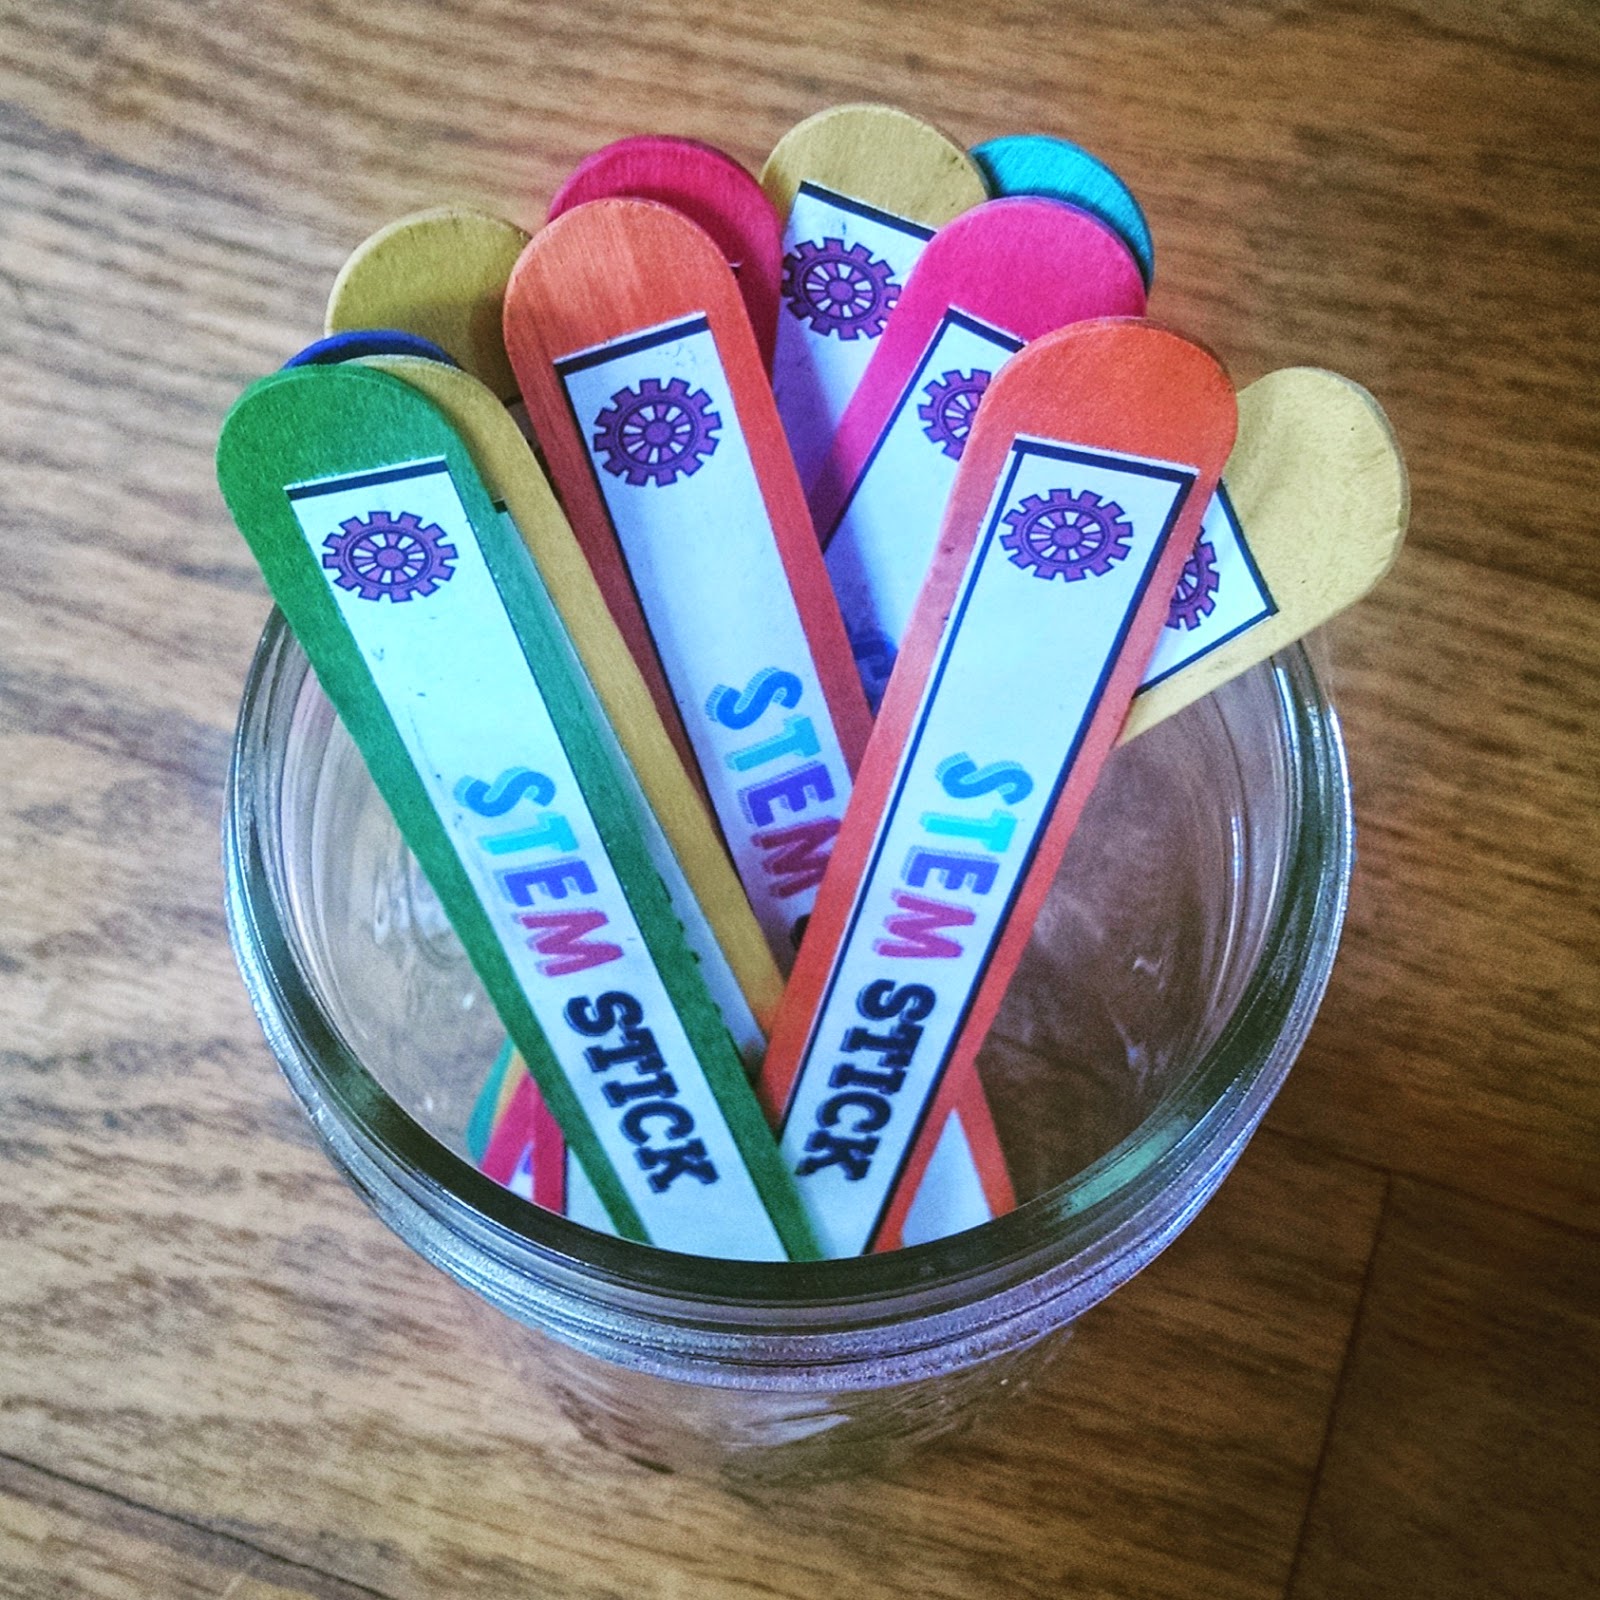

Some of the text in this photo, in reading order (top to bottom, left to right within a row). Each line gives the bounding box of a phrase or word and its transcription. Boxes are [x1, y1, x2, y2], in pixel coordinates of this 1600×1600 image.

[454, 767, 719, 1193] STEM STICK
[704, 667, 842, 898] STEM
[795, 751, 1035, 1181] STEM STICK
